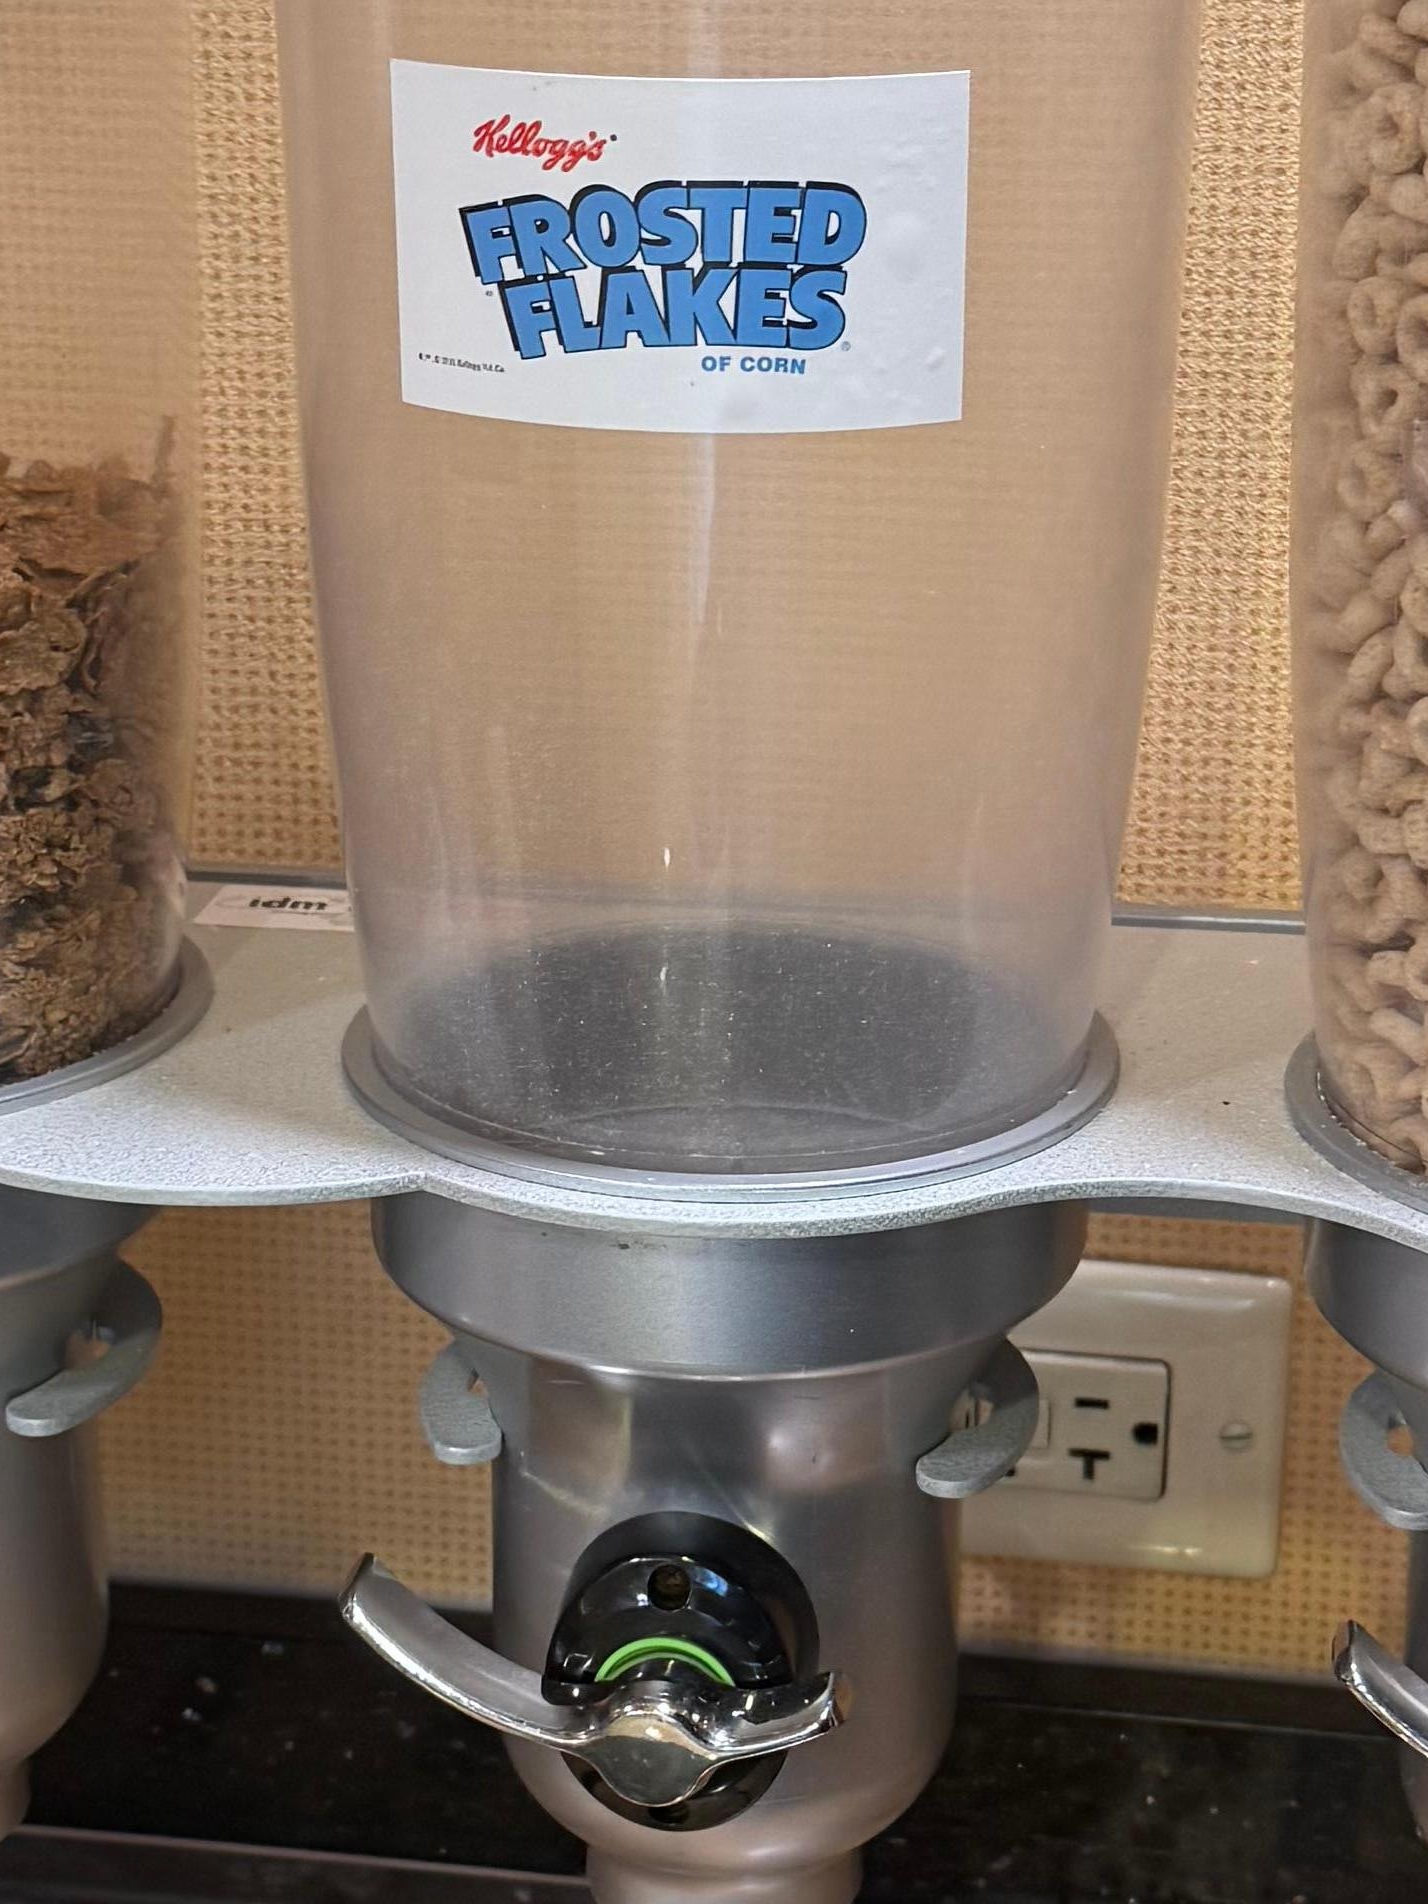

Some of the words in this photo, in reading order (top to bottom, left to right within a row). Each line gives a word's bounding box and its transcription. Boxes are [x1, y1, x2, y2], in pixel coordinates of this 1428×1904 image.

[473, 114, 607, 173] Kellogg's
[459, 180, 867, 285] FROSTED
[498, 264, 848, 360] FLAKES
[700, 355, 731, 373] OF
[739, 356, 807, 375] CORN
